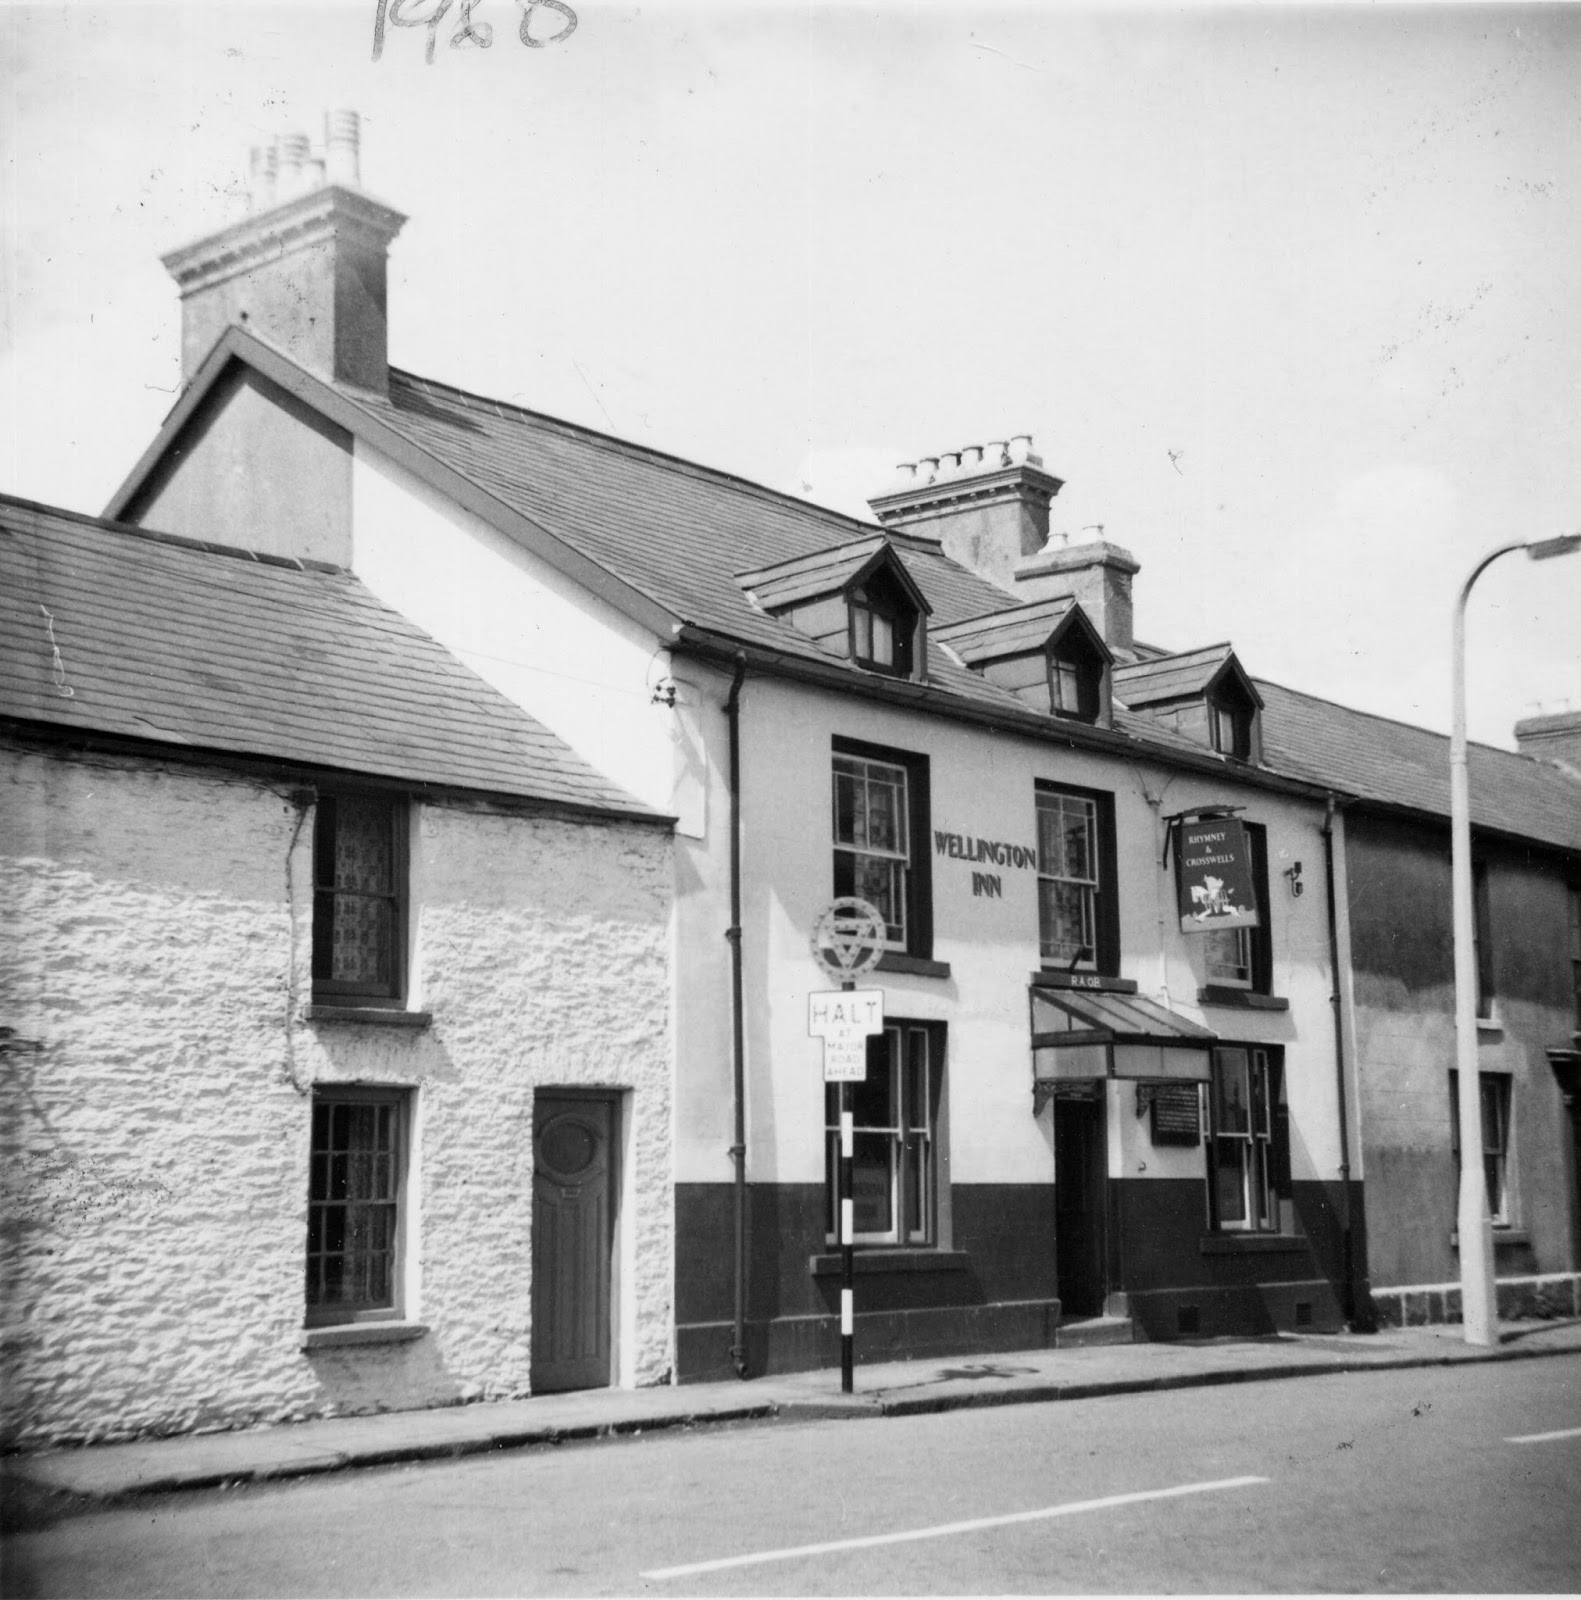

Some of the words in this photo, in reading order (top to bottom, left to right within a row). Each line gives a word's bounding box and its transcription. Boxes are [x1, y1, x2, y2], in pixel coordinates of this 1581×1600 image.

[1187, 831, 1226, 844] RHYMNEY
[934, 830, 1036, 870] WELLINGTON
[1205, 845, 1212, 854] &
[1186, 853, 1235, 867] CROSSWELLS
[972, 871, 1002, 898] INN
[812, 1002, 877, 1025] HALT
[838, 1028, 851, 1038] AT
[827, 1041, 864, 1051] MAJOR
[831, 1054, 861, 1064] ROAD
[827, 1066, 864, 1077] AHEAD
